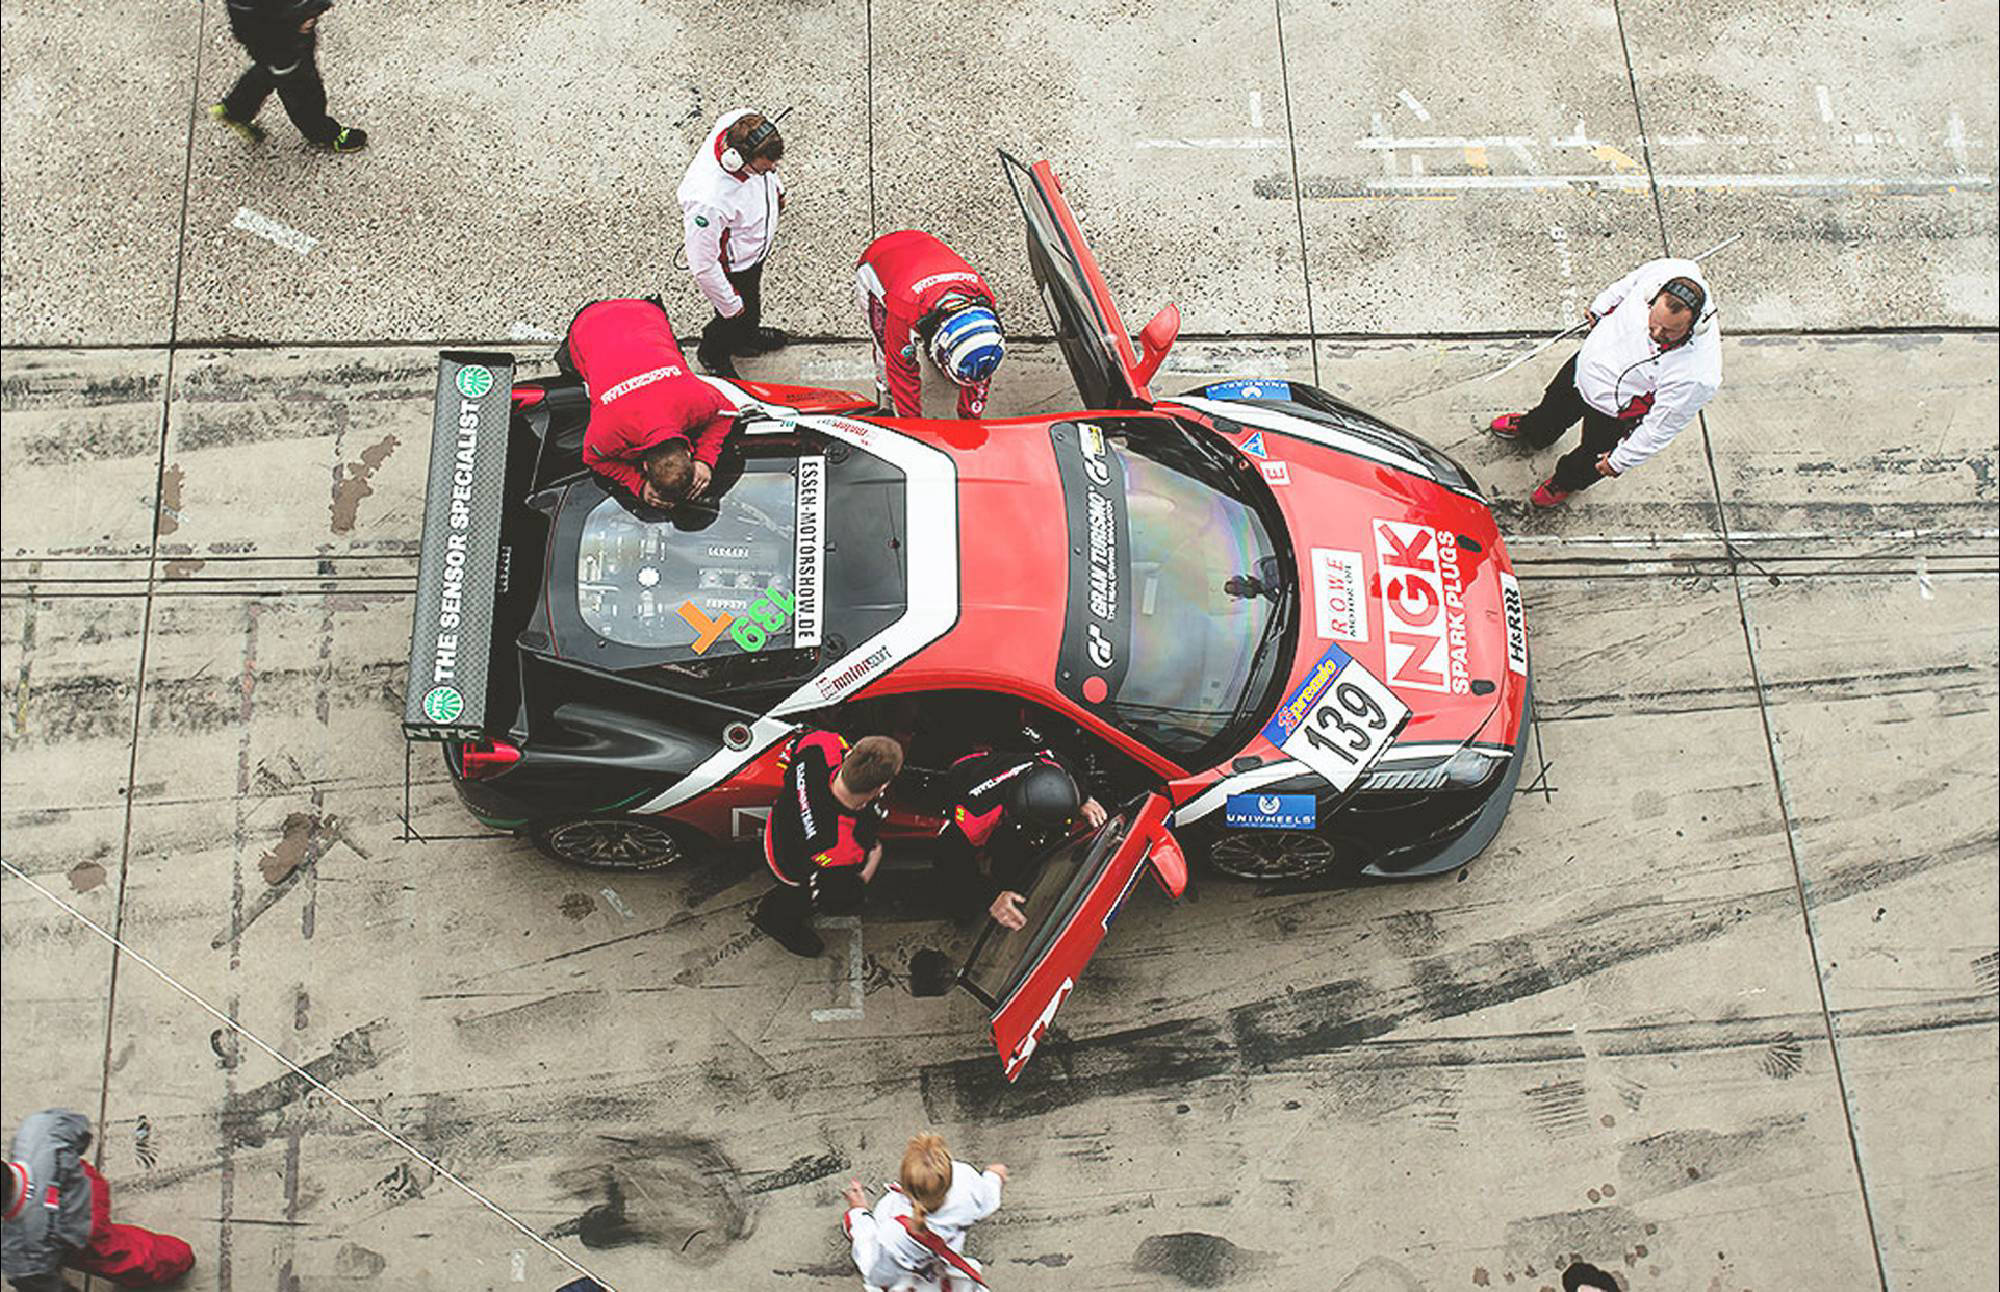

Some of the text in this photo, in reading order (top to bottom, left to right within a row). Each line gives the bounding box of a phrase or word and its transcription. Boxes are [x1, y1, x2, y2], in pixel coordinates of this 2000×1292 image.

[434, 400, 482, 682] THE SENSOR SPECIALIST
[798, 461, 820, 640] ESSEN-MOTORSHOW.DE
[1087, 490, 1108, 619] GRAN TURISMO
[730, 585, 795, 652] 139
[1327, 557, 1348, 635] ROWE
[1378, 523, 1445, 686] NGK
[1436, 529, 1471, 695] SPARK PLUGS
[1288, 657, 1338, 720] premio
[1301, 681, 1386, 766] 139
[1226, 813, 1316, 825] UNIWHEELS
